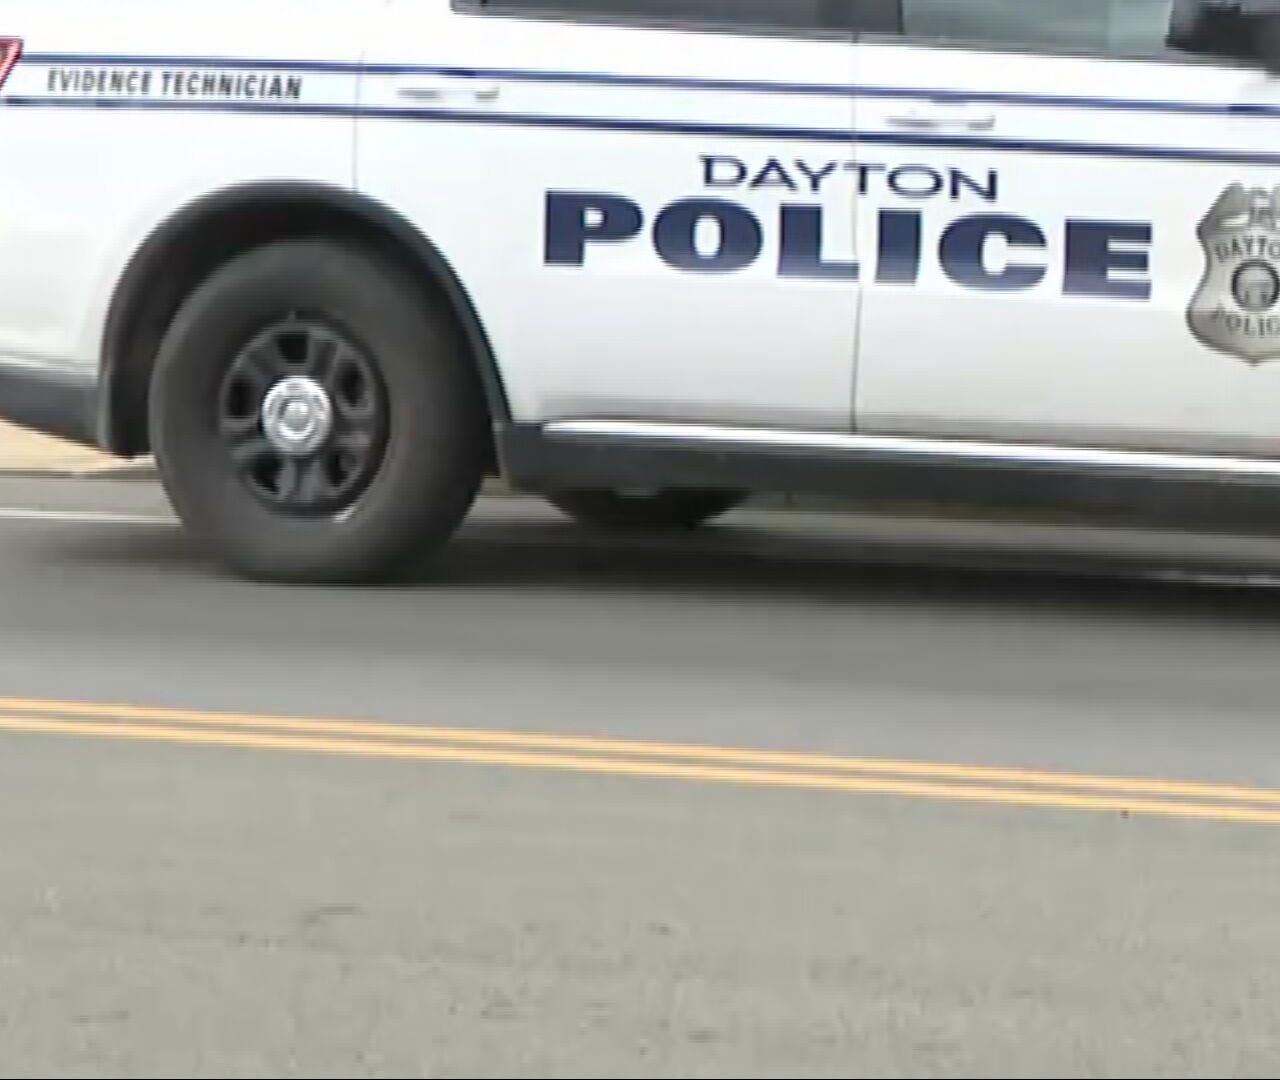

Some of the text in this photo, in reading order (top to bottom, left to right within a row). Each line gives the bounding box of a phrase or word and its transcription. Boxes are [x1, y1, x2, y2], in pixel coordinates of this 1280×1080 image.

[48, 67, 304, 100] EVIDENCE TECHNICIAN
[699, 154, 997, 202] DAYTON
[544, 189, 1153, 300] POLICE
